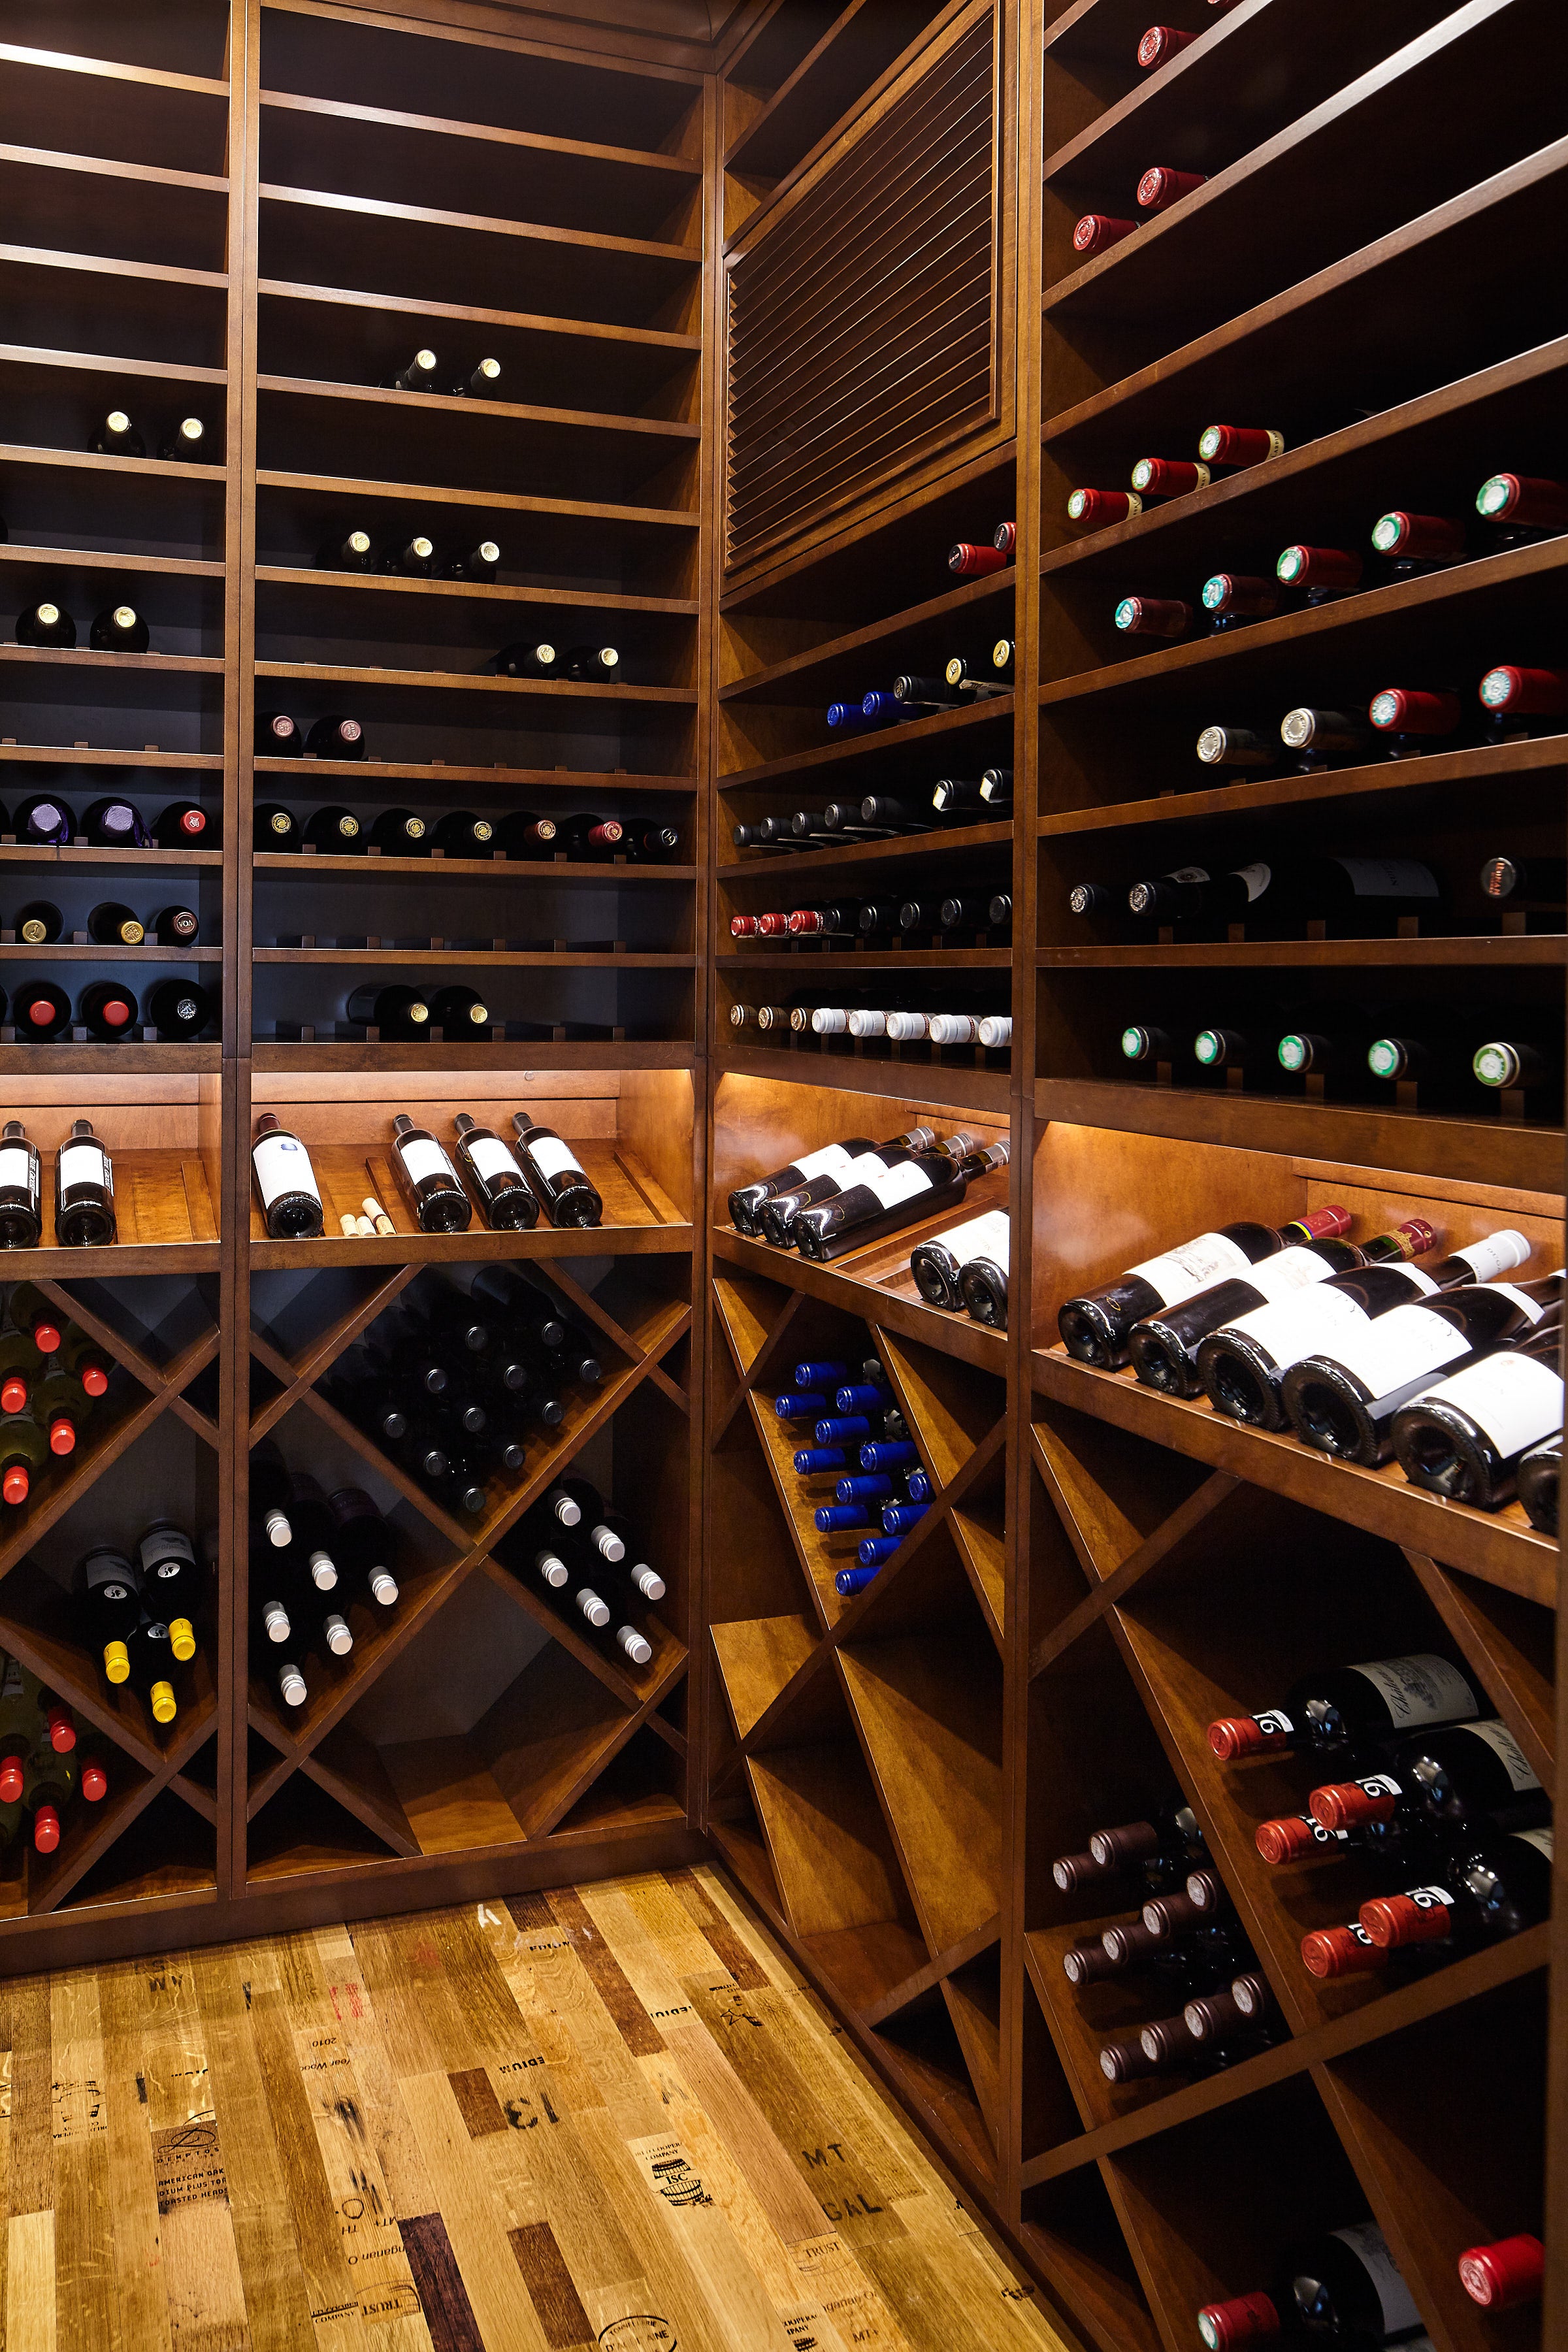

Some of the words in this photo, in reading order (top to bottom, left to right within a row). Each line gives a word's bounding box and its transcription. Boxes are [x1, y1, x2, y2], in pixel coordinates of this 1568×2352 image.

[650, 2006, 692, 2019] EDIU
[312, 2038, 336, 2047] 2010
[499, 2056, 545, 2074] EDIUM
[645, 2149, 679, 2161] COMPANY
[802, 2144, 846, 2169] MT
[158, 2172, 204, 2187] AMERICAN
[207, 2168, 224, 2176] OAK
[666, 2172, 688, 2185] ISC
[187, 2181, 208, 2191] PLUS
[158, 2194, 197, 2207] TOASTED
[803, 2242, 841, 2259] TRUST
[361, 2299, 402, 2317] TRUST
[315, 2310, 355, 2324] COMPANY
